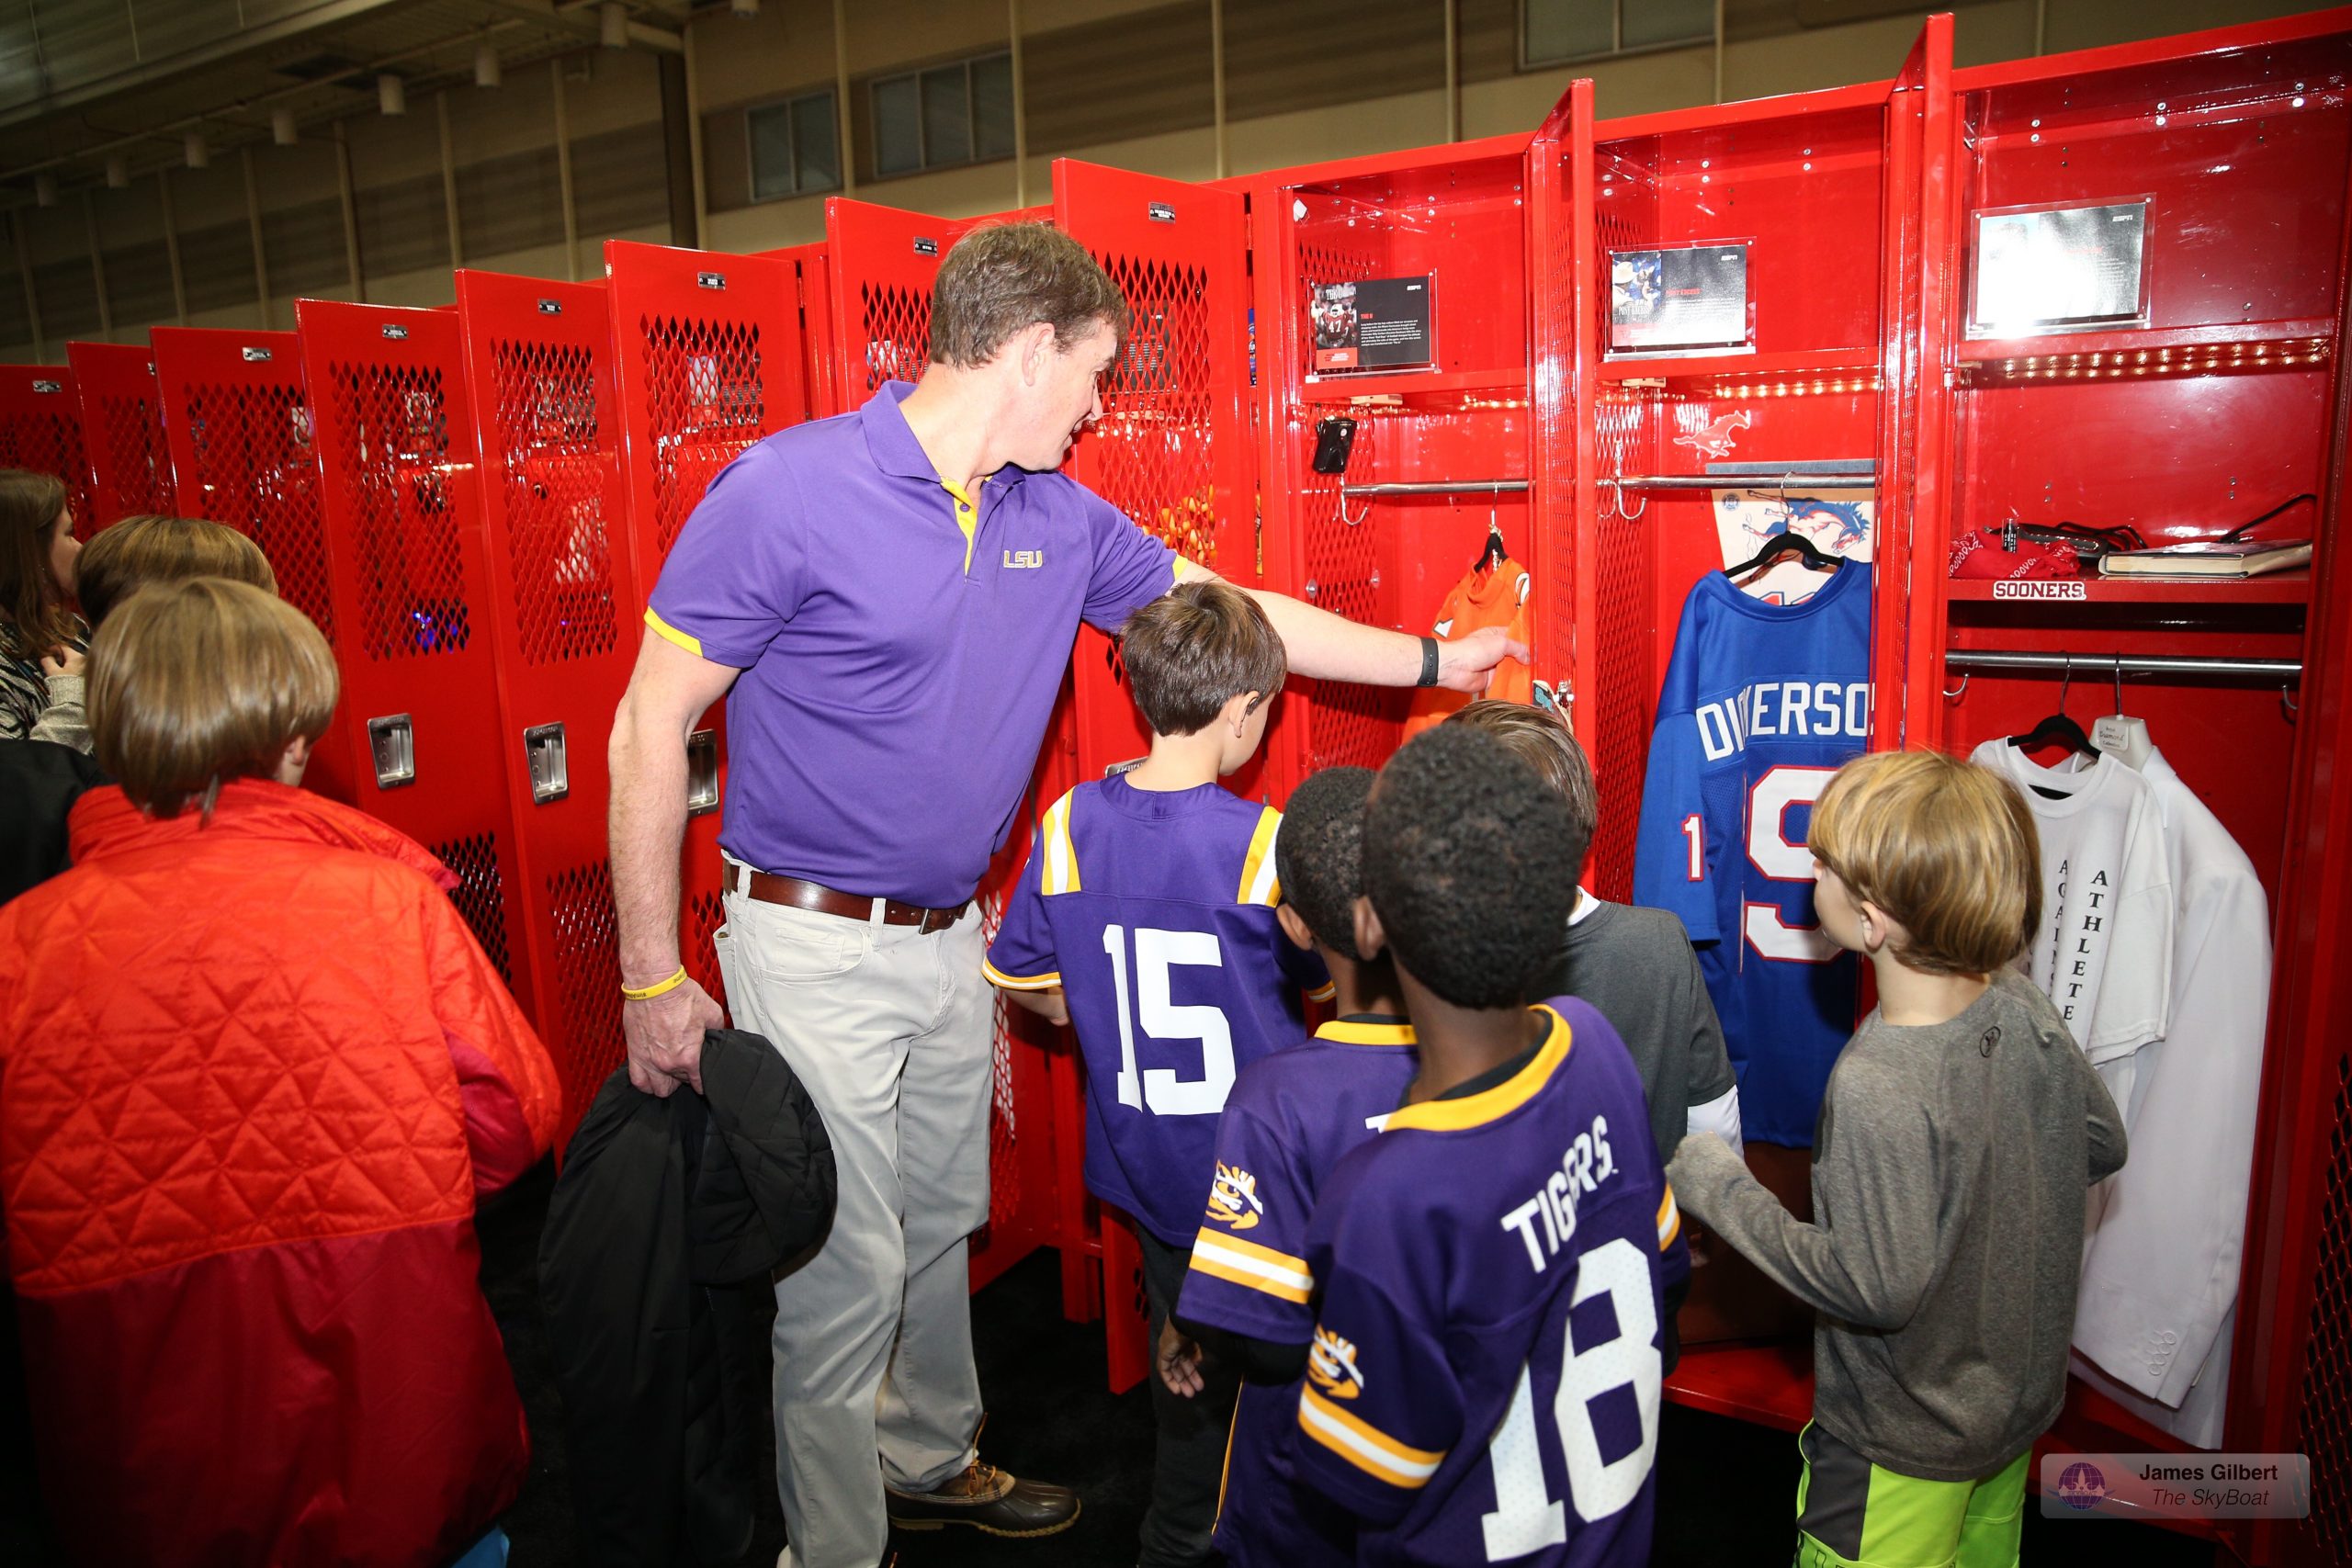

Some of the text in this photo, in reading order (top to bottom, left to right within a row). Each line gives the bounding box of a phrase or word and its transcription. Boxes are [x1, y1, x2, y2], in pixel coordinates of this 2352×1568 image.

[2112, 214, 2133, 222] ESPN
[1003, 549, 1043, 568] LSU
[1995, 582, 2083, 598] SOONERS
[1681, 813, 1703, 882] 1
[1102, 924, 1237, 1115] 15
[1482, 1237, 1663, 1562] 18
